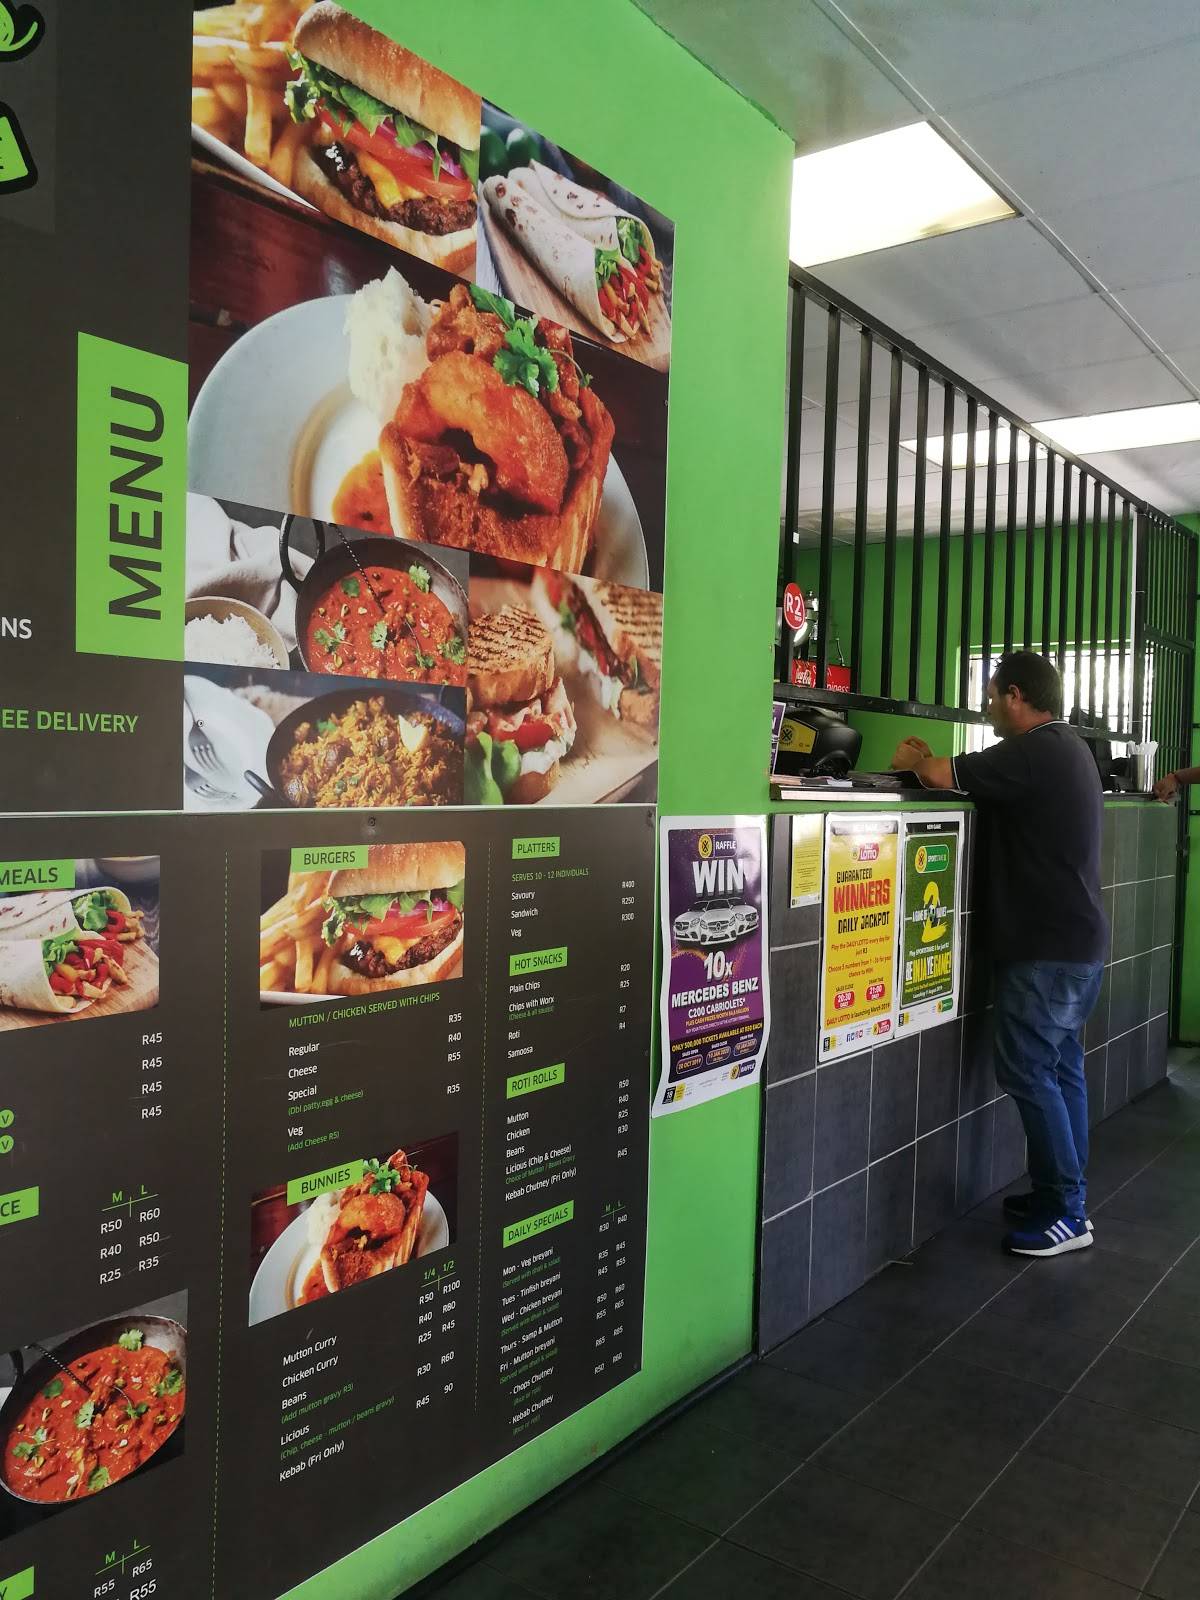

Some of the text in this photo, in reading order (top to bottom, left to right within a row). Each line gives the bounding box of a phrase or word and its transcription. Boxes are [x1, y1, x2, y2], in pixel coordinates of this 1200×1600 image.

[109, 386, 164, 621] MENU
[786, 592, 802, 616] R2
[37, 710, 138, 733] DELIVERY
[304, 851, 356, 865] BURGERS
[517, 843, 556, 854] PLATTERS
[715, 840, 737, 850] RAFFLE
[512, 868, 589, 882] SERVES 10 12 INDIVIDUALS
[692, 859, 745, 896] WIN
[512, 891, 536, 901] Savoury
[833, 879, 891, 915] WINNERS
[511, 908, 539, 919] Sandwich
[838, 911, 890, 934] DAILY JACKPOT
[511, 928, 522, 938] Veg
[515, 953, 563, 971] HOT SNACKS
[510, 964, 631, 994] Plain Chips R20
[671, 977, 759, 1008] MERCEDES BENZ
[289, 992, 441, 1028] MUTTON CHICKEN SERVED WITH CHIPS
[509, 980, 630, 1013] Chips with Worx R25
[688, 1006, 705, 1018] C200
[142, 1033, 163, 1046] R45
[289, 1013, 463, 1057] Regular R35
[509, 1030, 521, 1041] Roti
[142, 1057, 163, 1070] R45
[288, 1033, 462, 1079] Cheese R40
[508, 1046, 534, 1059] Samoosa
[142, 1081, 163, 1095] R45
[288, 1052, 461, 1101] Special R55
[512, 1070, 558, 1092] ROTI ROLLS
[341, 1090, 364, 1103] cheese)
[141, 1105, 163, 1120] R45
[288, 1084, 460, 1138] Veg R35
[507, 1111, 529, 1125] Mutton
[288, 1135, 327, 1153] (Add Cheese
[507, 1109, 629, 1158] Beans R25
[507, 1127, 531, 1142] Chicken
[506, 1160, 528, 1175] Licious
[529, 1154, 544, 1168] (Chip
[550, 1144, 572, 1159] Cheese)
[618, 1124, 629, 1135] R30
[113, 1185, 148, 1203] M L
[301, 1169, 351, 1195] BUNNIES
[506, 1167, 577, 1202] Kebab Chutney (Fri Only)
[101, 1207, 161, 1235] R50 R60
[509, 1207, 569, 1241] DAILY SPECIALS
[100, 1232, 160, 1260] R40 R50
[503, 1265, 516, 1277] Mon
[521, 1258, 532, 1269] Veg
[533, 1247, 554, 1263] breyani
[599, 1223, 610, 1233] R30
[100, 1256, 160, 1285] R25 R35
[424, 1261, 455, 1281] 1/4 1/2
[502, 1272, 561, 1307] Tues Tinfish breyani
[502, 1312, 515, 1325] Wed
[520, 1299, 542, 1315] Chicken
[542, 1288, 563, 1304] breyani
[283, 1280, 461, 1367] Mutton Curry R50 R100
[501, 1317, 563, 1355] Thurs Samp & Mutton
[282, 1301, 456, 1388] Chicken Curry R40 R80
[500, 1362, 509, 1373] Fri
[514, 1349, 534, 1365] Mutton
[535, 1336, 556, 1354] breyani
[282, 1320, 456, 1410] Beans R25 R45
[513, 1366, 554, 1395] Chops Chutney
[281, 1351, 455, 1446] Licious R30 R60
[299, 1391, 342, 1415] mutton gravy
[513, 1408, 531, 1425] Kebab
[532, 1395, 554, 1412] Chutney
[279, 1383, 454, 1482] Kebab (Fri Only) R45 90
[105, 1540, 141, 1564] M L
[94, 1559, 153, 1598] R55 R65
[130, 1579, 157, 1600] R55
